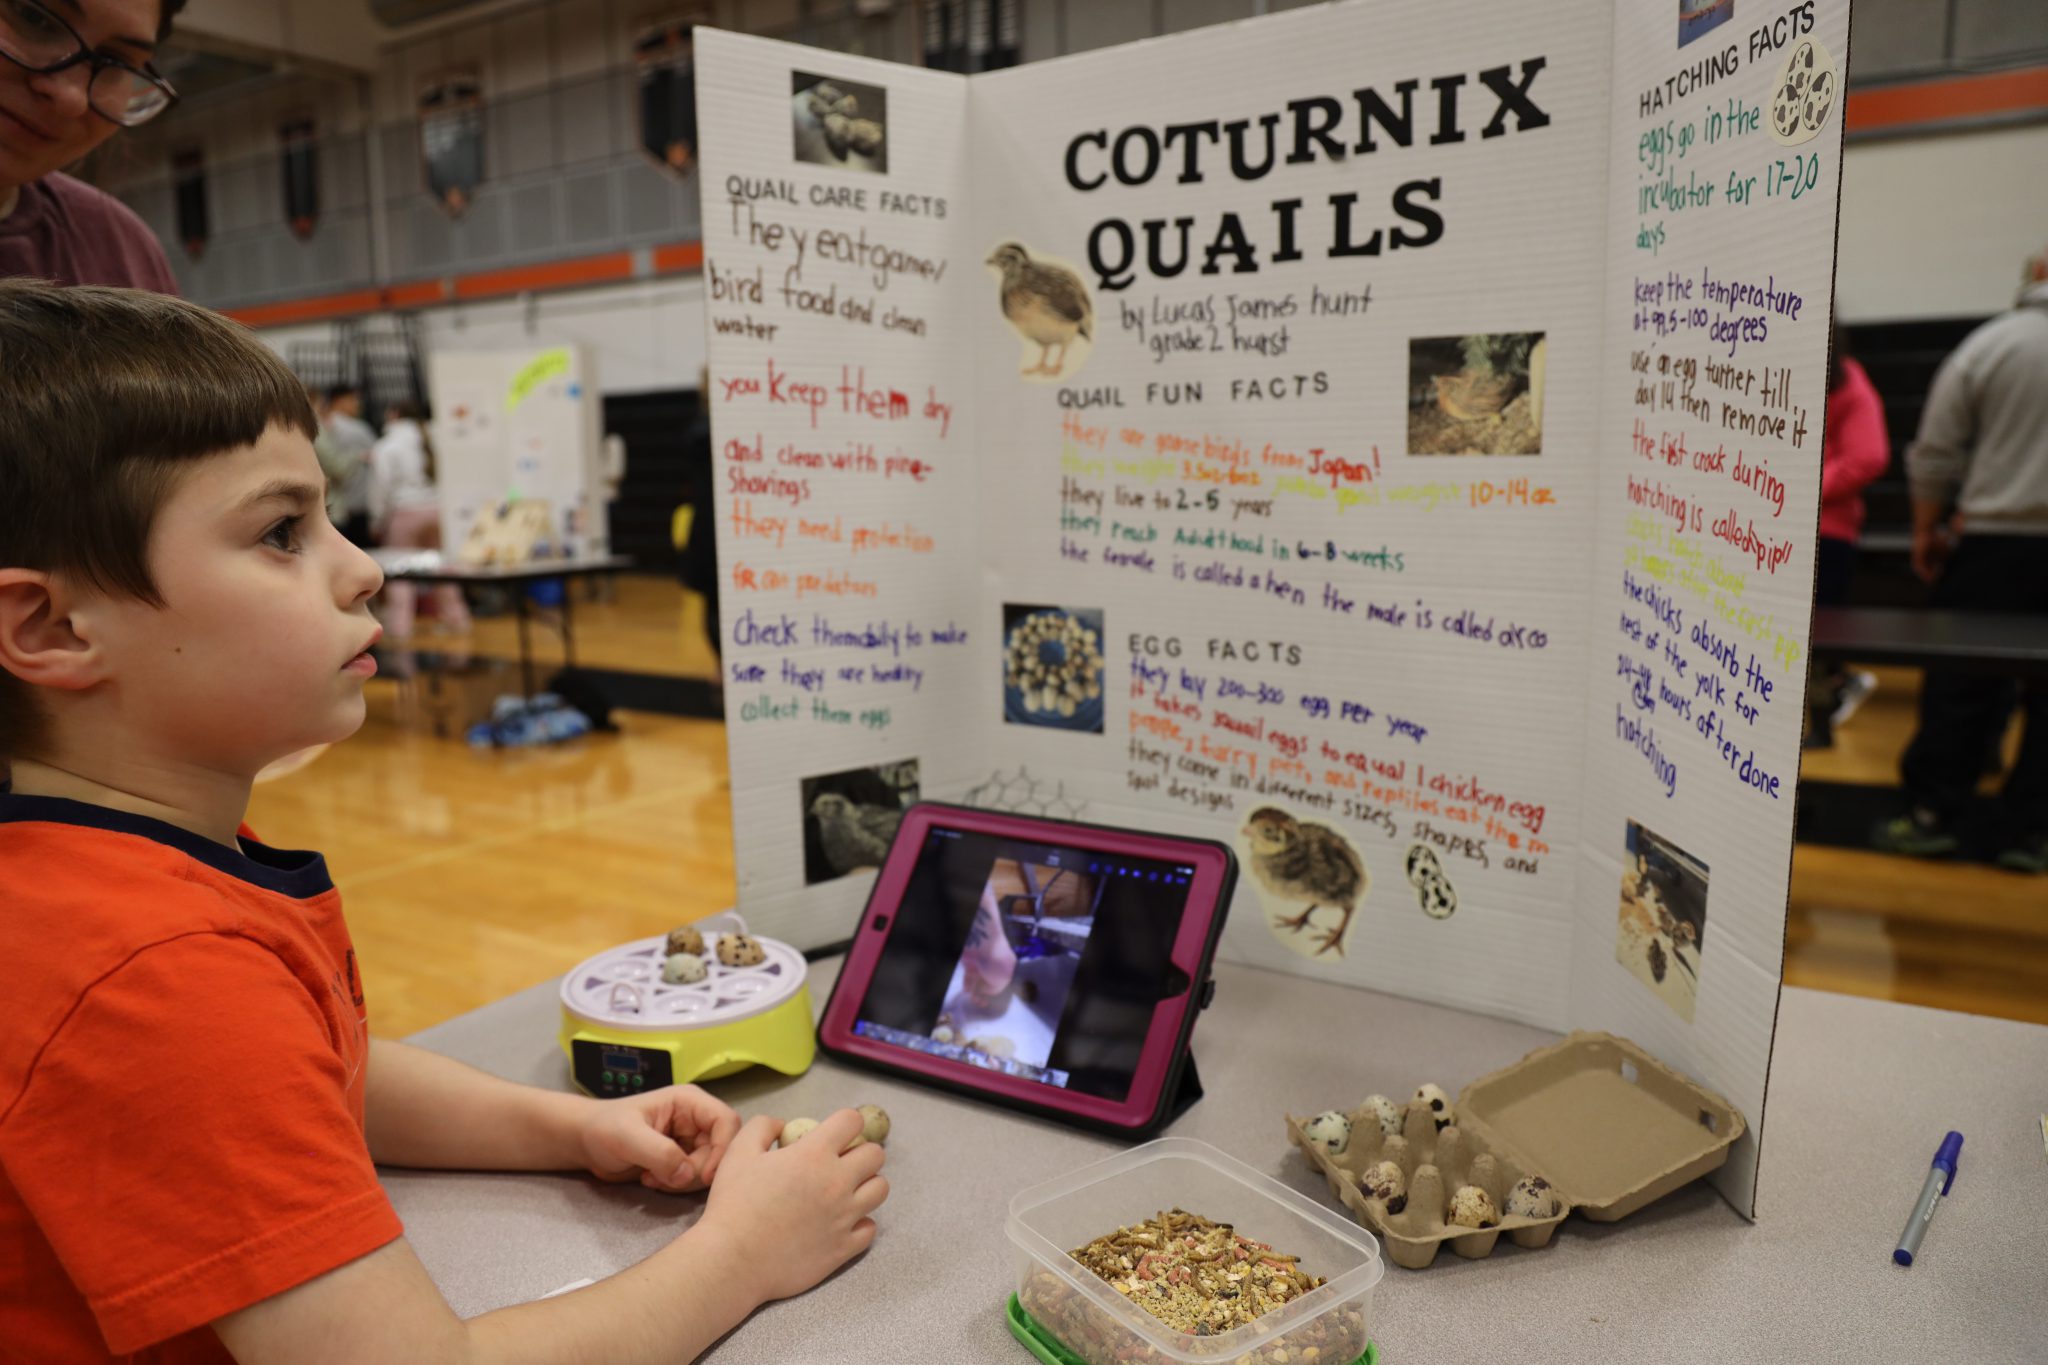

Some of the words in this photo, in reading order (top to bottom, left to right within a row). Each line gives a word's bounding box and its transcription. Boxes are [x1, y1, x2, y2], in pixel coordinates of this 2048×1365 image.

[1639, 45, 1739, 119] HATCHING
[1749, 0, 1815, 64] FACTS
[1064, 55, 1551, 192] COTURNIX
[1639, 119, 1675, 177] eggs
[1679, 123, 1695, 159] go
[1704, 105, 1723, 145] in
[1726, 98, 1760, 139] the
[726, 175, 799, 205] QUAIL
[809, 184, 867, 212] CARE
[879, 191, 947, 219] FACTS
[1638, 164, 1715, 215] incubator
[1725, 170, 1757, 206] for
[1767, 152, 1819, 200] 17-20
[728, 197, 806, 281] They
[1086, 176, 1445, 292] QUAILS
[1636, 220, 1666, 257] days
[708, 257, 764, 304] bird
[777, 264, 835, 316] food
[840, 298, 875, 325] and
[1120, 298, 1145, 344] by
[1152, 294, 1216, 325] Lucas
[1225, 292, 1299, 327] James
[1311, 283, 1373, 317] hunt
[1635, 276, 1664, 307] keep
[1667, 271, 1693, 302] the
[1702, 266, 1803, 321] temperature
[713, 315, 779, 342] water
[1150, 326, 1203, 364] grade
[1206, 324, 1224, 352] 2
[1710, 313, 1768, 358] degrees
[719, 376, 761, 402] you
[1057, 386, 1125, 409] QUAIL
[1147, 381, 1203, 405] FUN
[1231, 371, 1329, 400] FACTS
[1760, 367, 1791, 409] till
[1722, 402, 1786, 440] remove
[1792, 406, 1808, 449] it
[829, 441, 878, 473] with
[1632, 417, 1656, 460] the
[1733, 449, 1785, 518] during
[731, 496, 787, 550] they
[1060, 474, 1104, 516] they
[1115, 483, 1145, 509] live
[1626, 474, 1687, 533] hatching
[1691, 494, 1704, 533] is
[1712, 508, 1752, 552] called
[1194, 561, 1243, 587] called
[1323, 581, 1354, 613] the
[1415, 599, 1433, 629] is
[1442, 609, 1494, 642] called
[780, 658, 825, 692] they
[1128, 633, 1182, 658] EGG
[1208, 638, 1301, 666] FACTS
[1692, 618, 1739, 678] absorb
[1745, 654, 1773, 702] the
[1665, 638, 1688, 678] the
[1695, 671, 1725, 706] yolk
[1735, 691, 1759, 726] for
[1615, 702, 1677, 799] hatching
[1740, 750, 1780, 799] done
[1320, 740, 1340, 762] to
[1344, 751, 1405, 781] equal
[1429, 774, 1506, 813] chicken
[1508, 801, 1545, 834] egg
[1230, 768, 1249, 789] in
[1503, 855, 1539, 875] and
